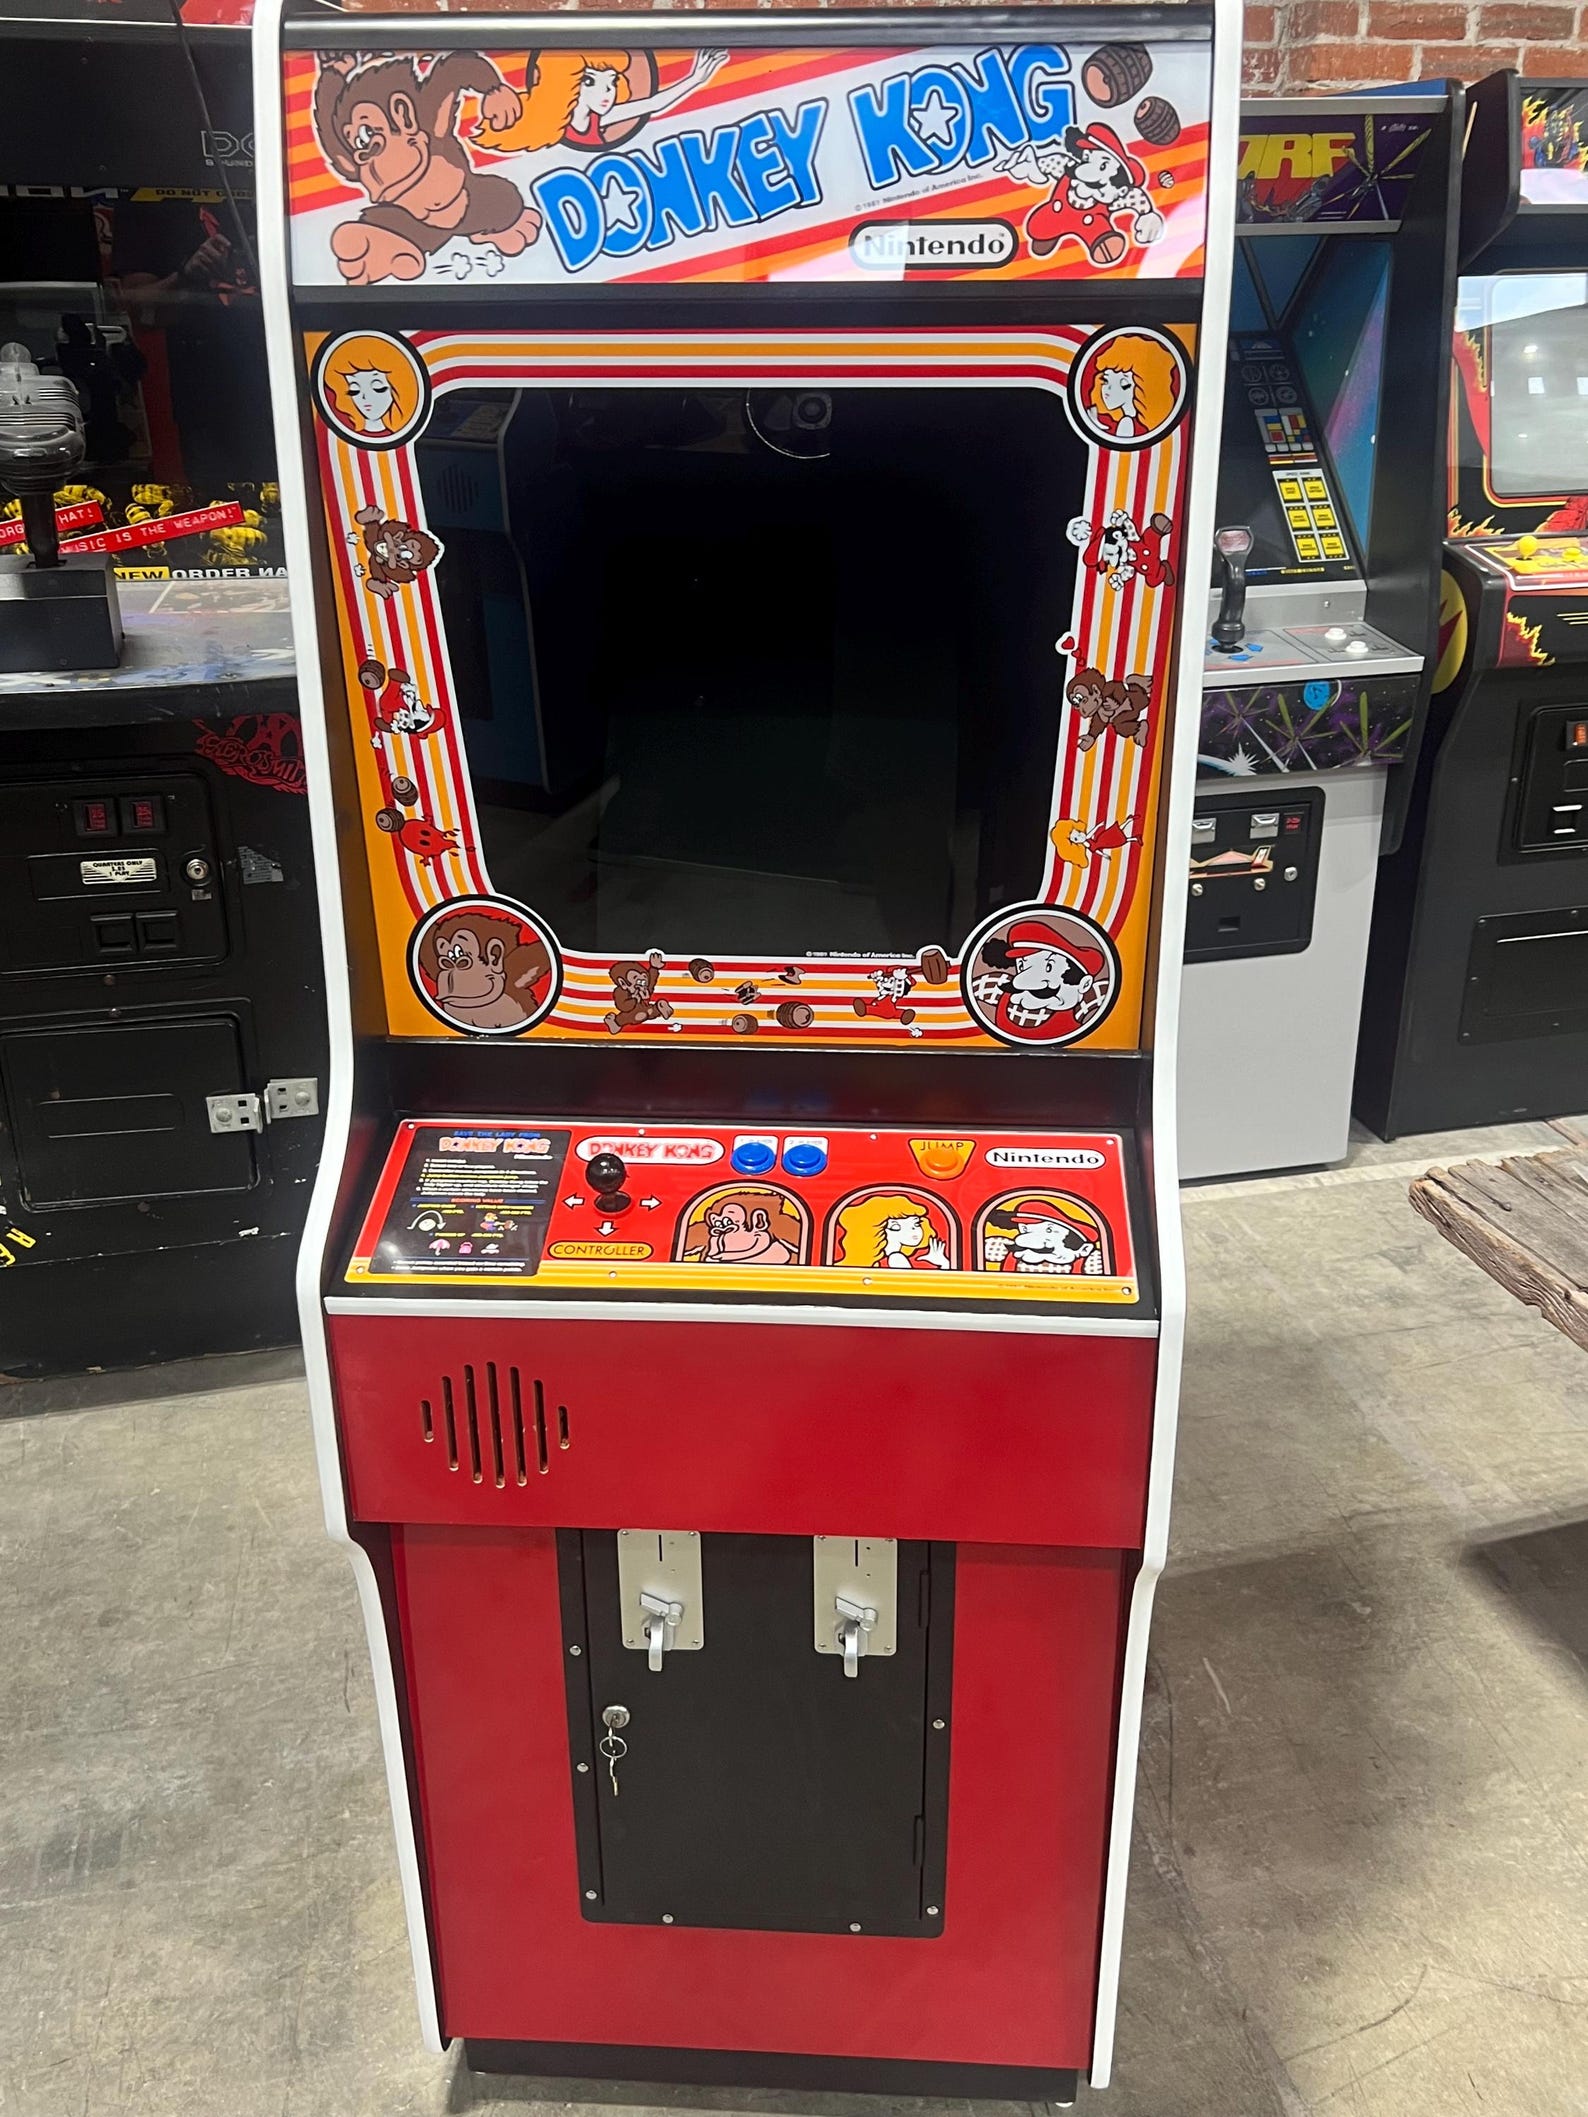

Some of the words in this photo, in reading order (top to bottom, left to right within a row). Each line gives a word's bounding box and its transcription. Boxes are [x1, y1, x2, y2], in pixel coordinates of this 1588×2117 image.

[530, 97, 829, 273] DONKEY
[847, 43, 1077, 190] KONG
[882, 189, 920, 203] Nintendo
[931, 177, 967, 191] America
[863, 233, 1005, 257] Nintendo
[116, 531, 133, 544] IS
[140, 523, 167, 537] THE
[588, 1142, 660, 1158] DONKEY
[662, 1143, 716, 1159] KONG
[920, 1141, 964, 1151] JUMP
[993, 1151, 1099, 1165] Nintendo
[553, 1244, 645, 1256] CONTROLLER
